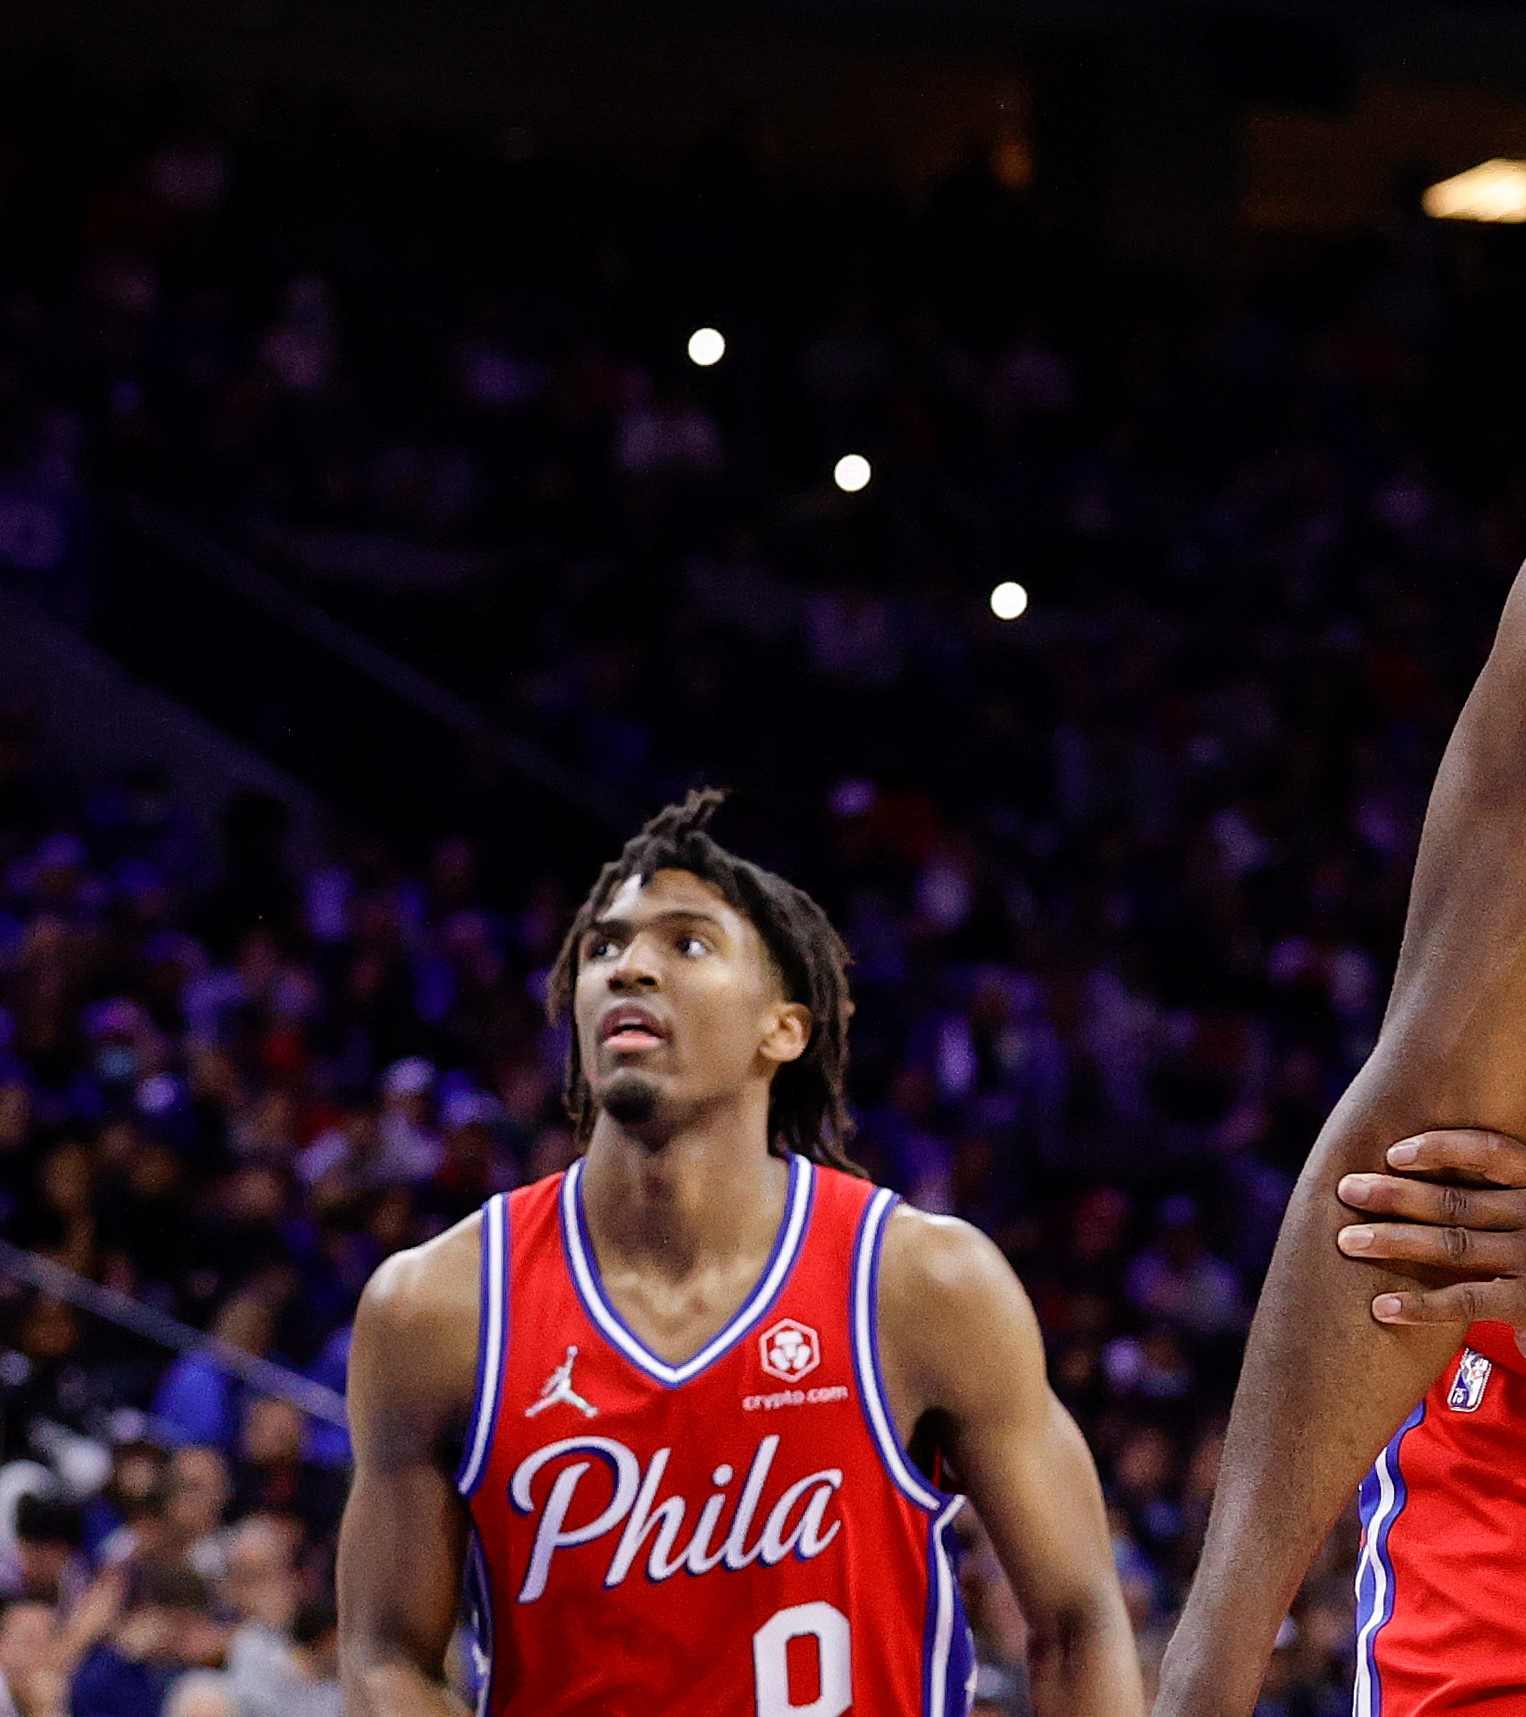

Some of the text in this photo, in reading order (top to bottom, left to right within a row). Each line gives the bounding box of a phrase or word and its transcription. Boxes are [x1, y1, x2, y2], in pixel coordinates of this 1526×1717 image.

[742, 1385, 849, 1411] crypto.com
[508, 1434, 843, 1604] Phila
[753, 1600, 853, 1717] 0
